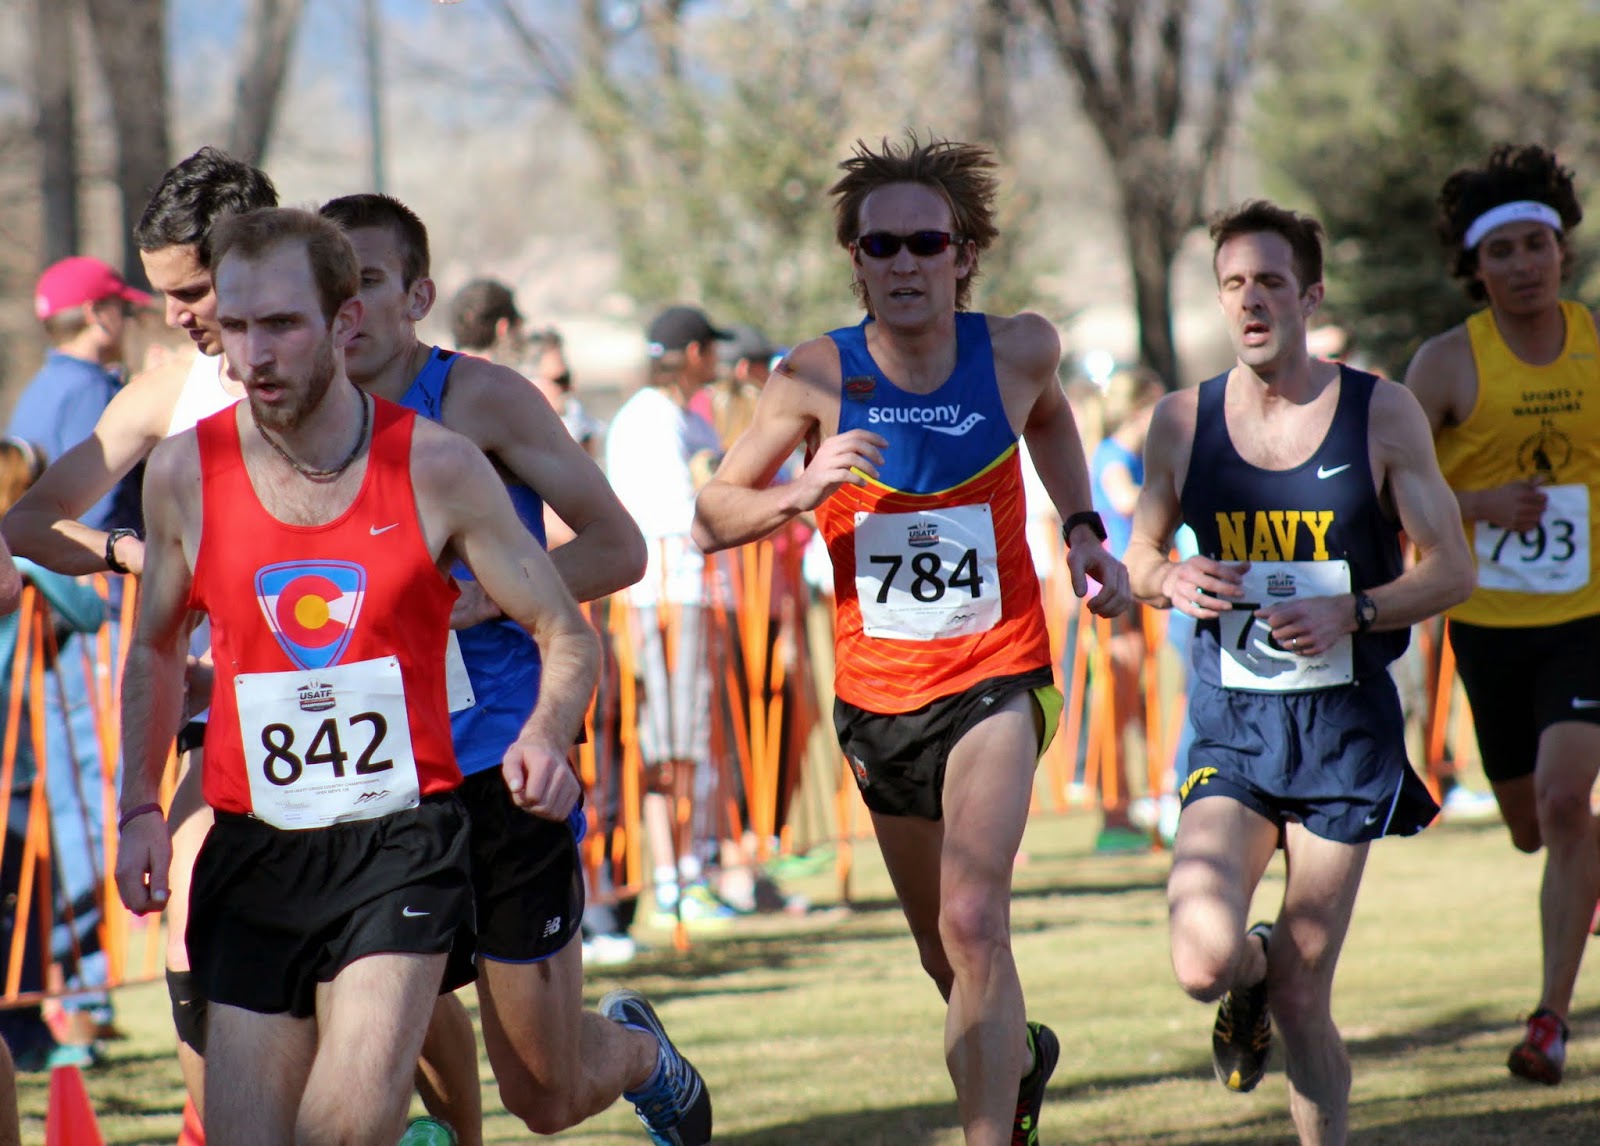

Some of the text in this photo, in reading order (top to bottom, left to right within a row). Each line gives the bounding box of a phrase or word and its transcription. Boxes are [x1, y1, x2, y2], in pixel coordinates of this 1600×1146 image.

[868, 404, 961, 424] saucony
[909, 529, 937, 537] USATF
[1215, 509, 1334, 562] NAVY
[1488, 520, 1576, 564] 793
[870, 548, 984, 604] 784
[300, 690, 332, 700] USATF
[261, 711, 394, 786] 842
